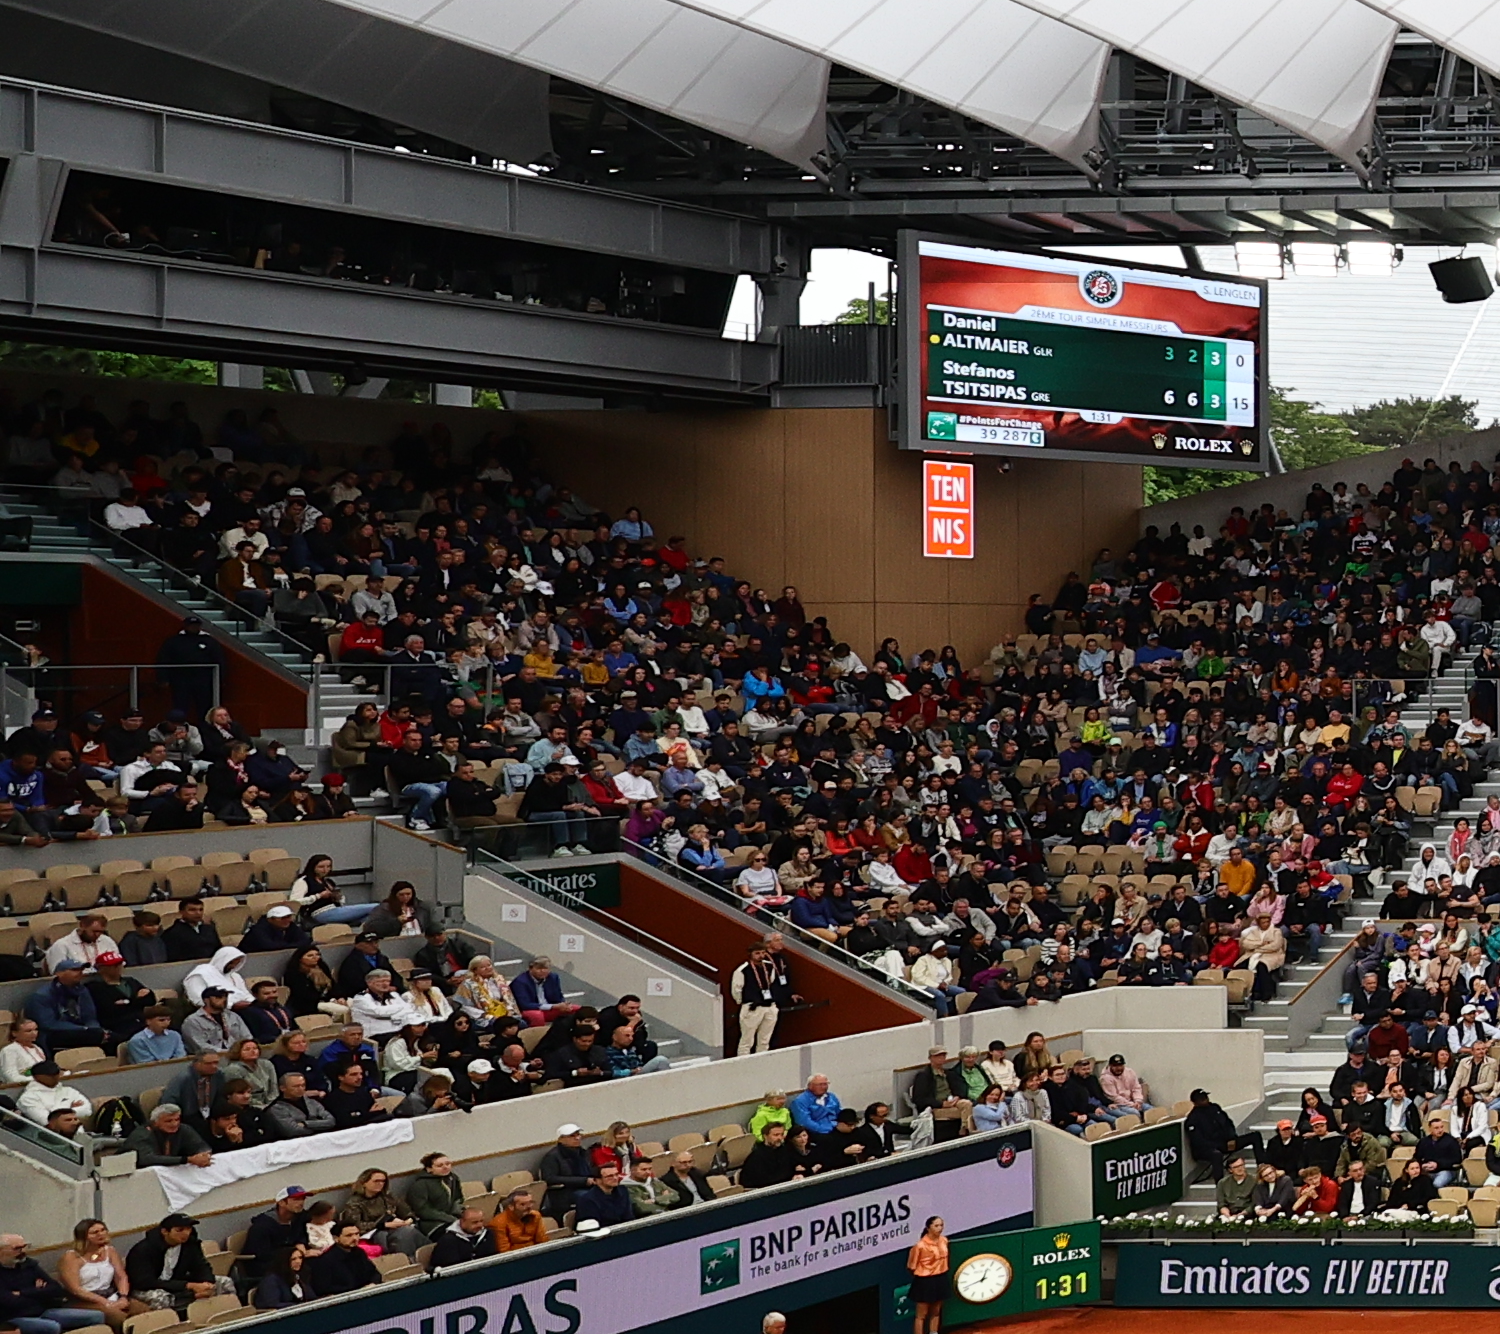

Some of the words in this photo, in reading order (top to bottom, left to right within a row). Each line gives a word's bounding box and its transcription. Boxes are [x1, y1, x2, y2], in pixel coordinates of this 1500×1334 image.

[1214, 286, 1257, 301] LENGLEN
[943, 313, 997, 332] Daniel
[1058, 312, 1083, 323] TOUR
[1085, 315, 1118, 327] SIMPLE
[943, 333, 1029, 355] ALTMAIER
[1164, 347, 1174, 360] 3
[1188, 349, 1198, 363] 2
[1210, 351, 1221, 366] 3
[943, 360, 1015, 380] Stefanos
[942, 380, 1027, 400] TSITSIPAS
[1031, 391, 1051, 402] GRE
[1164, 390, 1175, 405] 6
[1187, 392, 1199, 407] 6
[1210, 394, 1221, 409] 3
[1233, 397, 1249, 410] 15
[1091, 412, 1111, 422] 1:31
[1174, 436, 1233, 453] ROLEX
[931, 475, 965, 502] TEN
[933, 518, 965, 545] NIS
[1106, 1144, 1178, 1182] Emirates
[1116, 1181, 1133, 1200] FLY
[1135, 1170, 1167, 1196] BETTER
[750, 1225, 802, 1263] BNP
[810, 1195, 911, 1246] PARIBAS
[750, 1264, 770, 1279] The
[774, 1254, 801, 1272] bank
[803, 1249, 820, 1267] for
[832, 1233, 879, 1255] changing
[881, 1223, 910, 1241] world
[1032, 1246, 1091, 1266] ROLEX
[1035, 1271, 1088, 1301] 1:31
[1160, 1258, 1310, 1294] Emirates
[1322, 1259, 1362, 1295] FLY
[1366, 1259, 1450, 1295] BETTER
